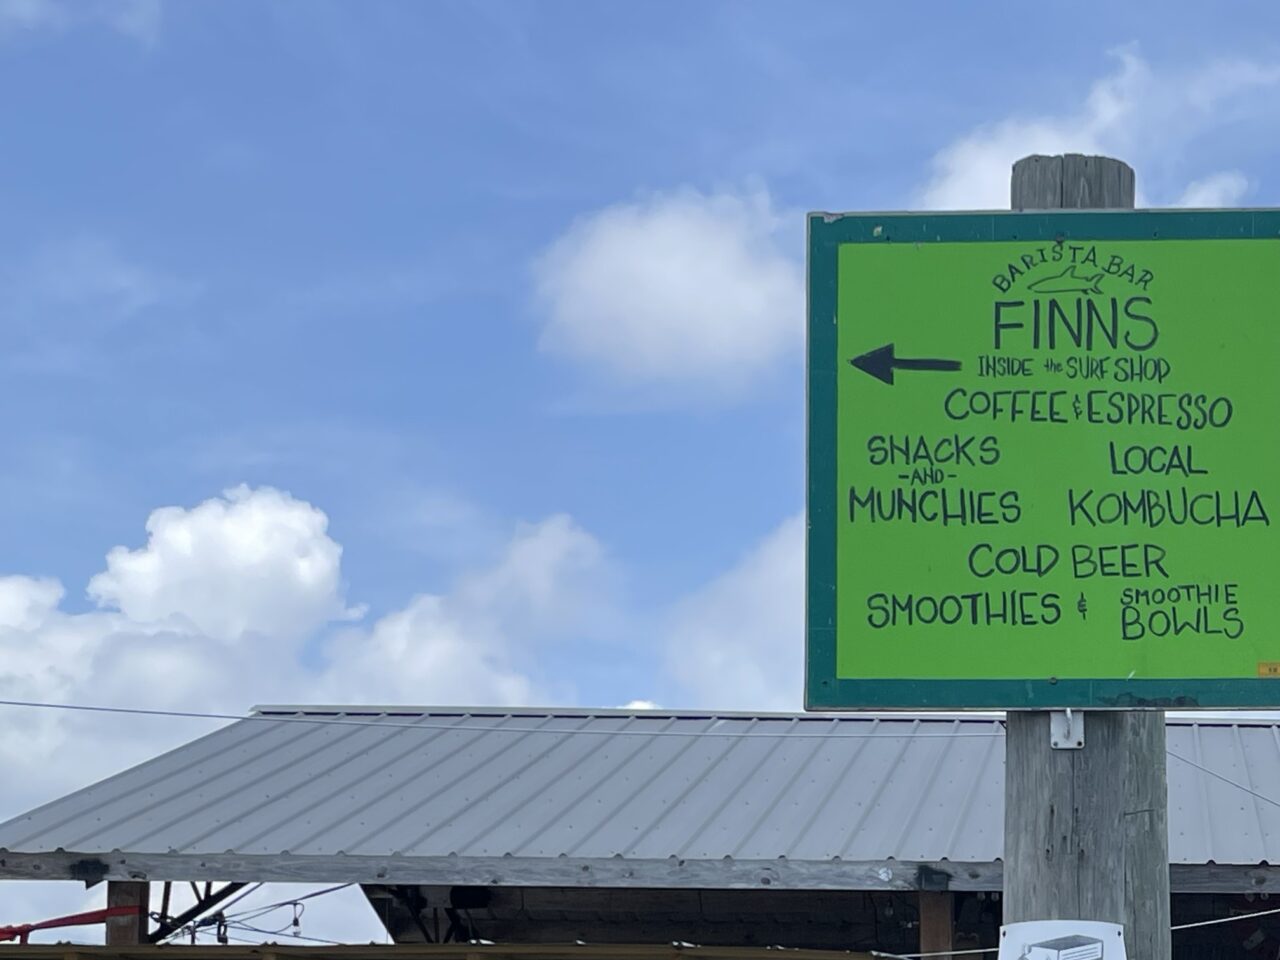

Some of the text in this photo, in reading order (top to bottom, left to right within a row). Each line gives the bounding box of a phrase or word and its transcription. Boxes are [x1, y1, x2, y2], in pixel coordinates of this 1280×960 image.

[992, 243, 1154, 293] BARISTA BAR
[994, 296, 1159, 351] FINNS
[978, 354, 1171, 384] INSIDE the SURF SHOP
[944, 388, 1069, 424] COFFEE
[1087, 391, 1233, 430] ESPRESSO
[867, 435, 1000, 466] SNACKS
[1109, 441, 1209, 476] LOCAL
[849, 486, 1021, 524] MUNCHIES
[1068, 489, 1270, 527] KOMBUCHA
[968, 544, 1169, 579] COLD BEER
[867, 591, 1061, 628] SMOOTHIES
[1120, 584, 1238, 606] SMOOTHIE
[1121, 606, 1244, 640] BOWLS
